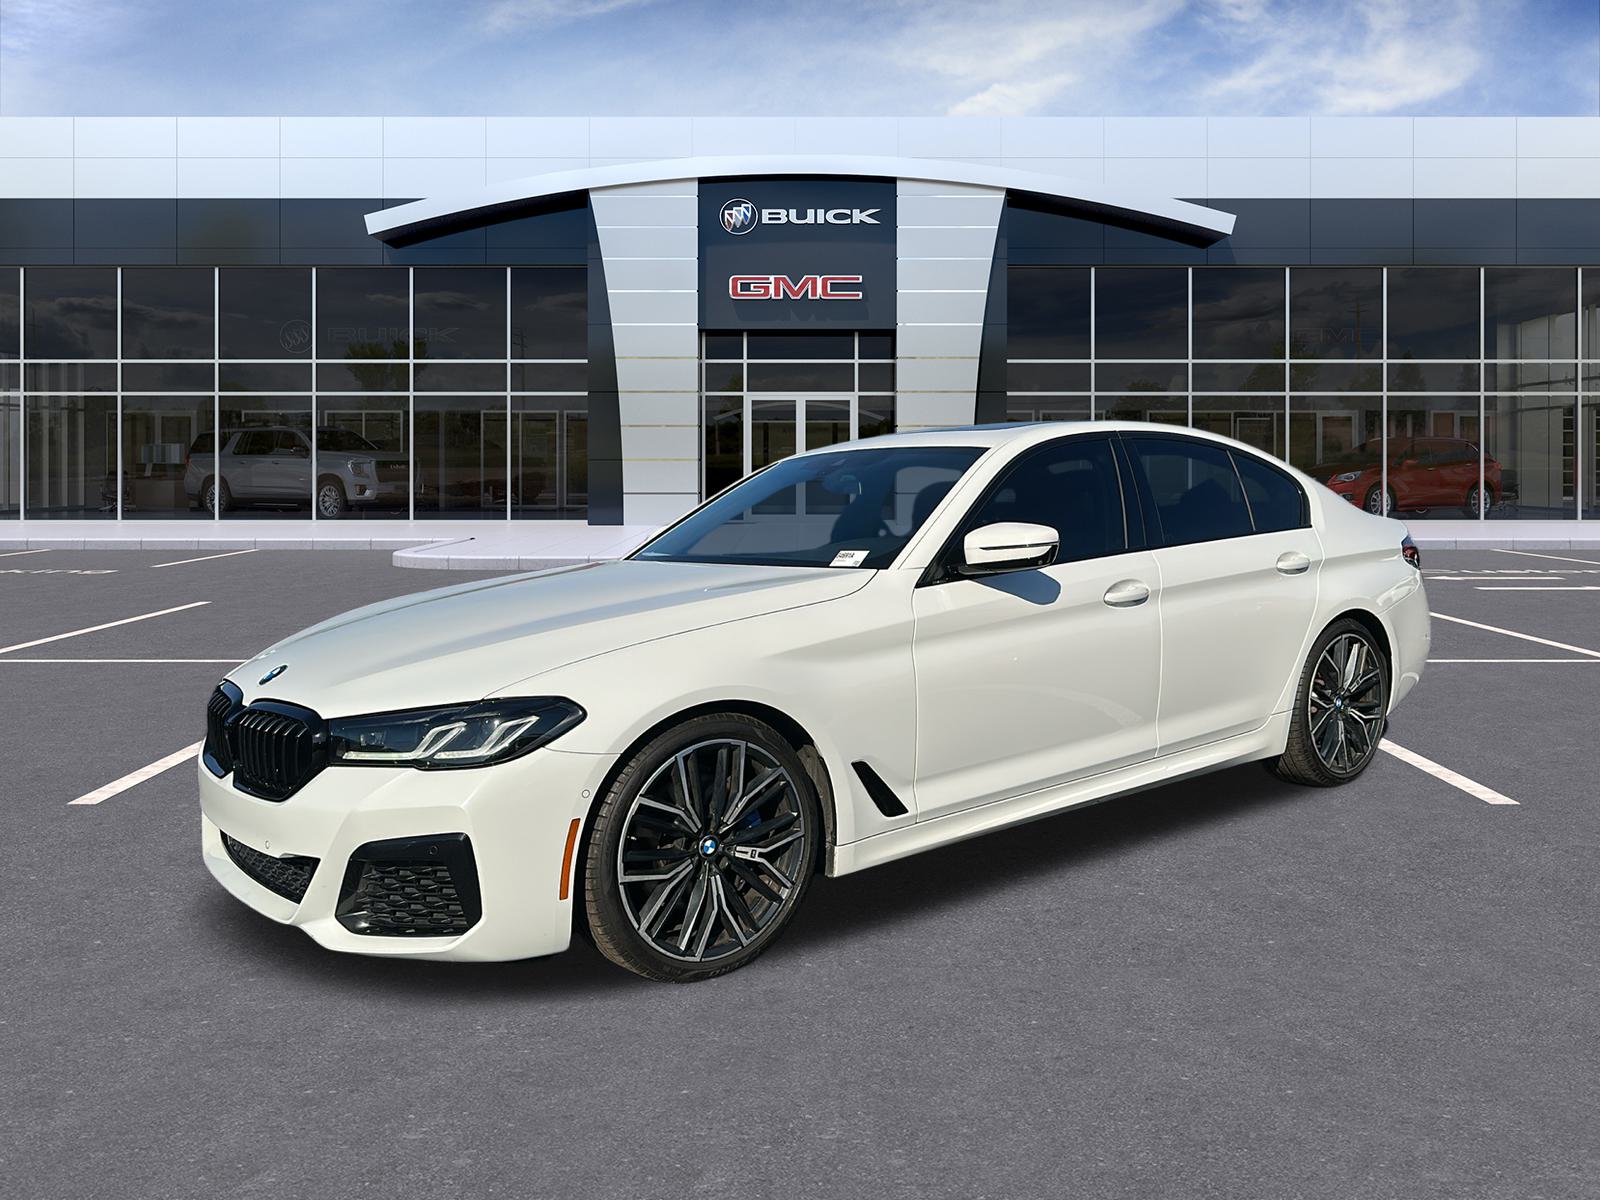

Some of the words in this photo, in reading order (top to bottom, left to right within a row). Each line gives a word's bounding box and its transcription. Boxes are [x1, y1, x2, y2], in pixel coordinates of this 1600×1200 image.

[761, 208, 881, 224] BUICK
[729, 275, 863, 300] GMC
[327, 327, 459, 343] BUICK
